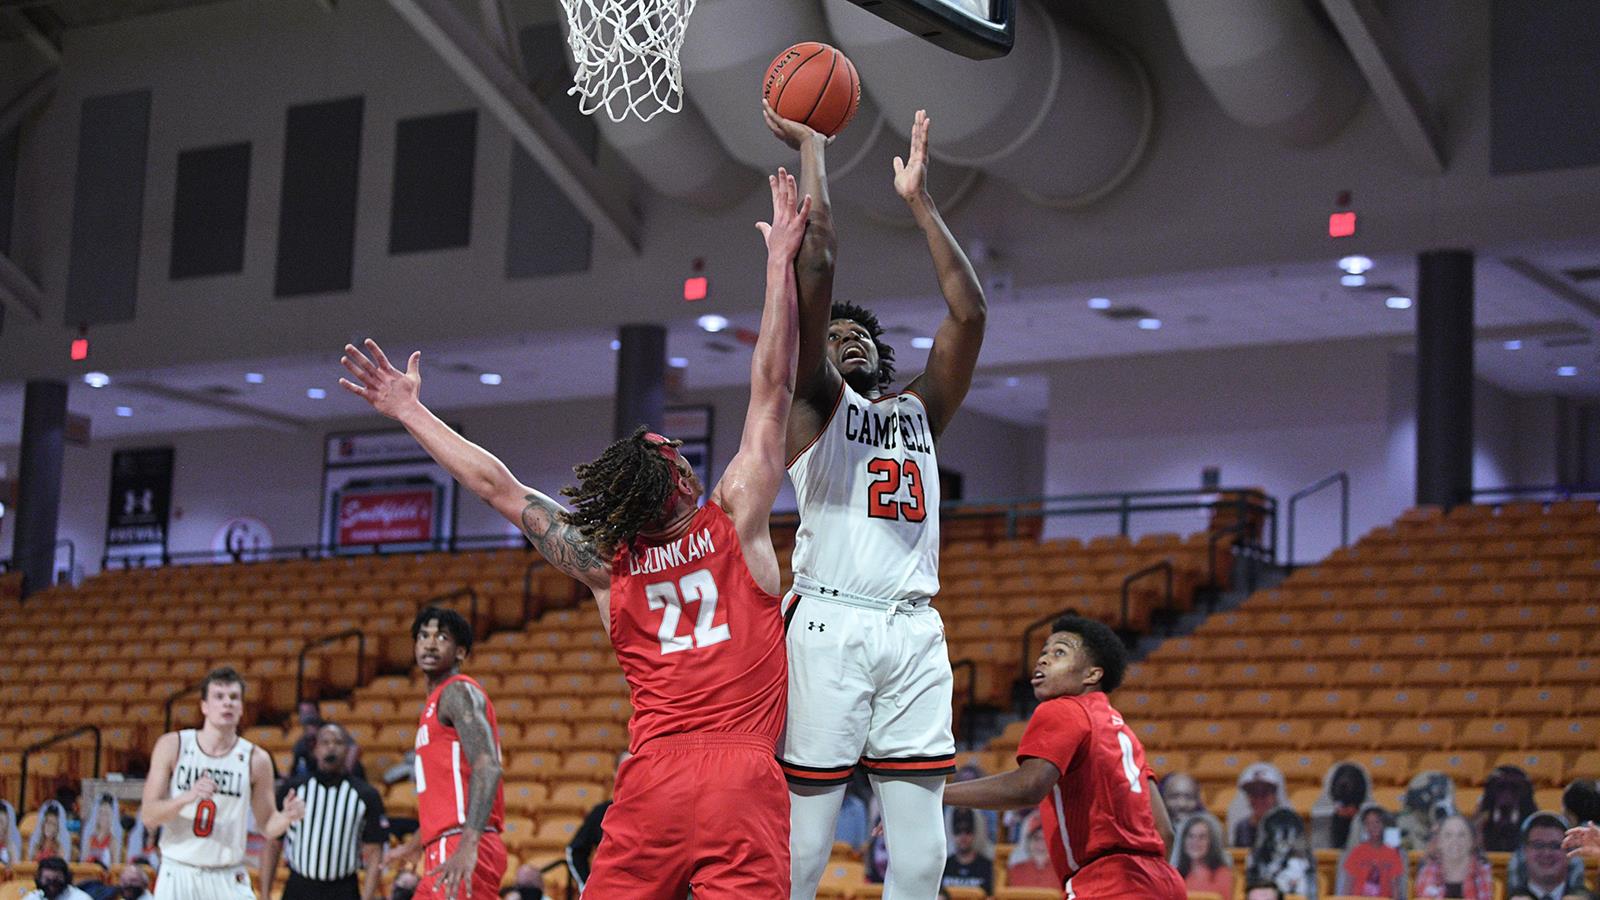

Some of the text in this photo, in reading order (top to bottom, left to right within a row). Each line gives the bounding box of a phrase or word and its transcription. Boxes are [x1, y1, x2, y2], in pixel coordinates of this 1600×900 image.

[845, 403, 931, 454] CAMPELL
[867, 457, 928, 522] 23
[629, 527, 716, 576] DJONKAM
[645, 568, 731, 655] 22
[193, 797, 217, 838] 0
